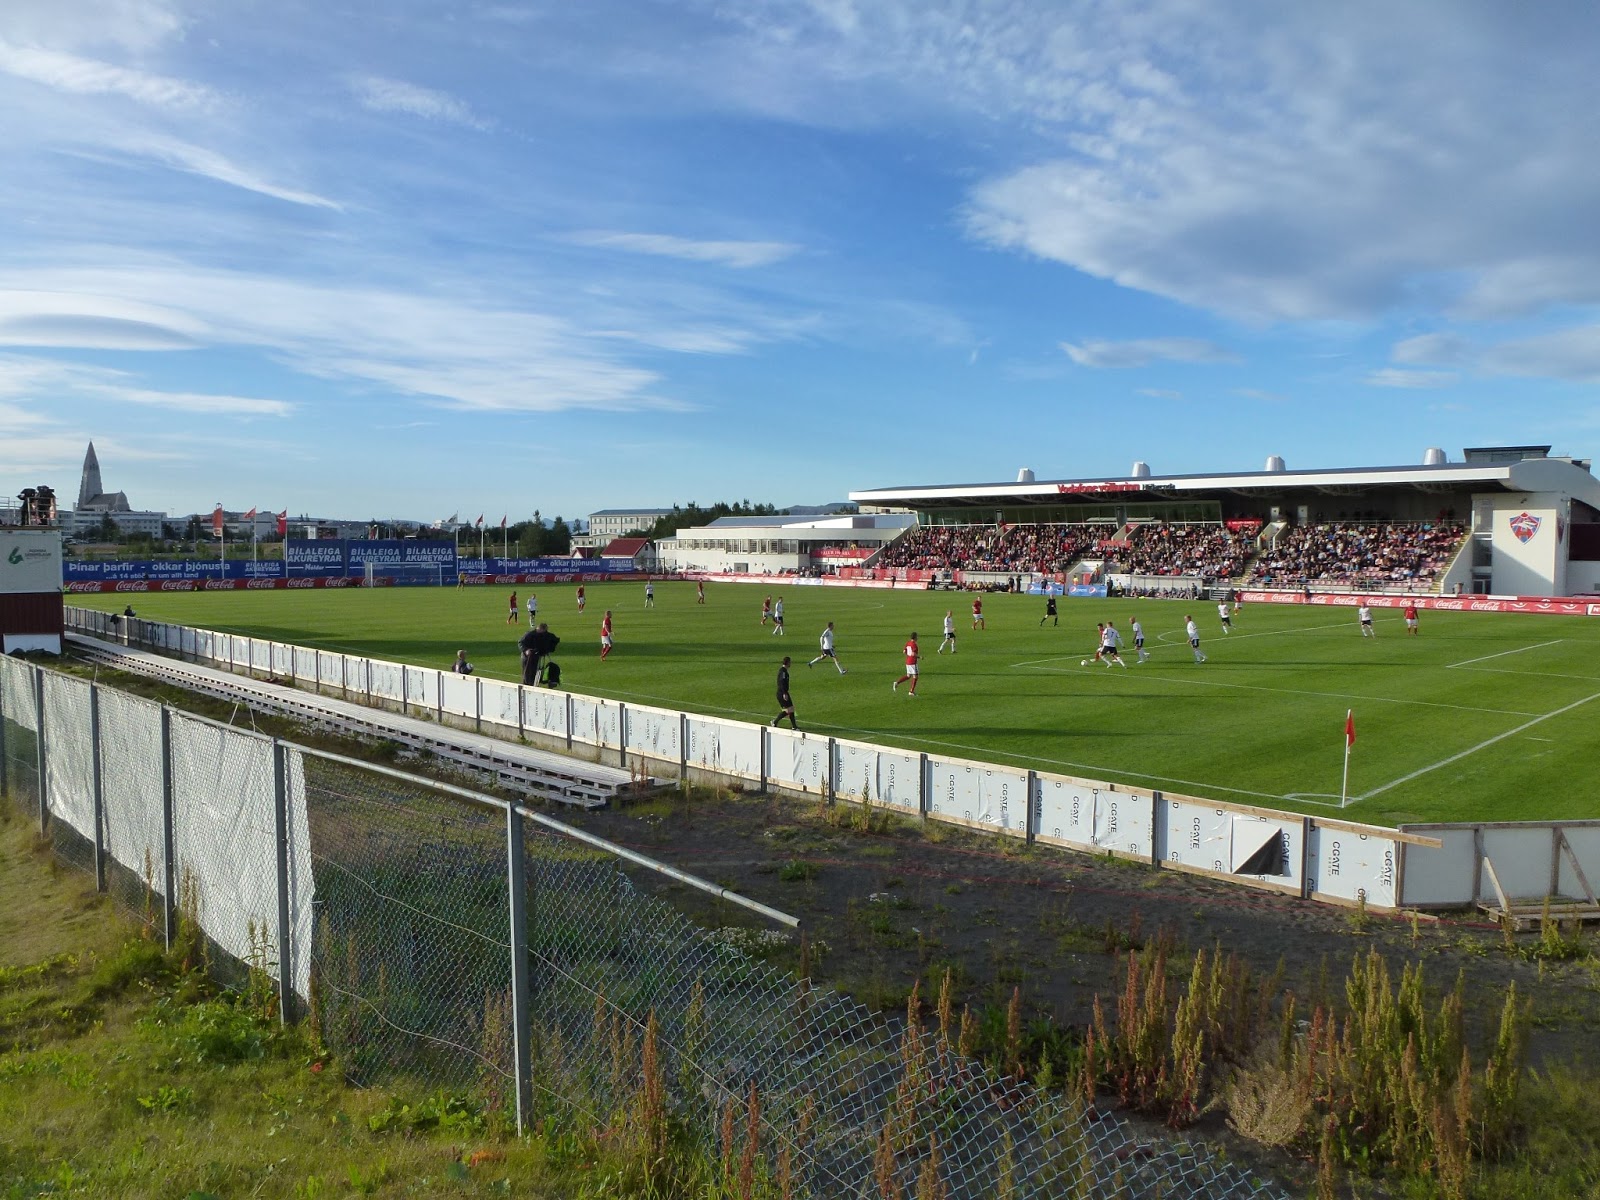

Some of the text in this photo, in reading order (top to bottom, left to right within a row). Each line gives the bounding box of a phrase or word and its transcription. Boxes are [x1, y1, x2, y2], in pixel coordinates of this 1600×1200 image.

[288, 547, 340, 555] BÍLALEIGA
[406, 546, 452, 554] BÍLALEIGA
[152, 562, 182, 570] okkar
[1282, 832, 1290, 866] CGATE
[1332, 841, 1340, 876] CGATE
[1384, 850, 1392, 886] CGATE
